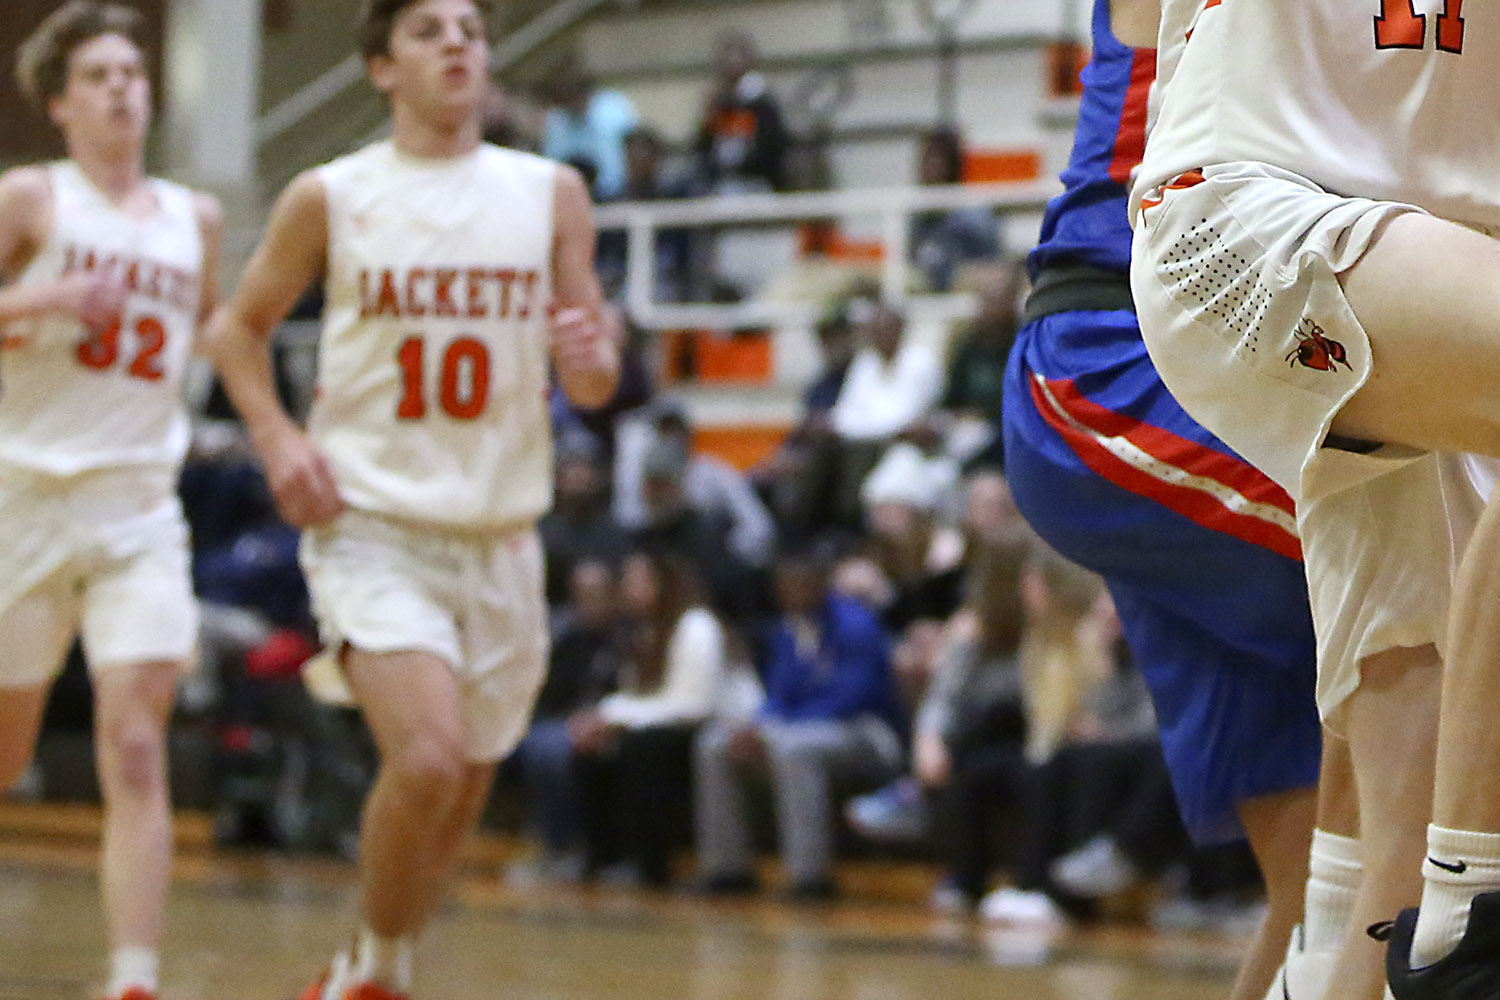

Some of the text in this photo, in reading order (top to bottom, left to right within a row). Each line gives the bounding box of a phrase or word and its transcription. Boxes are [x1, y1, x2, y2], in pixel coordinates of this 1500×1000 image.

[358, 266, 541, 321] JACKETS
[76, 304, 167, 383] 32
[396, 334, 491, 422] 10
